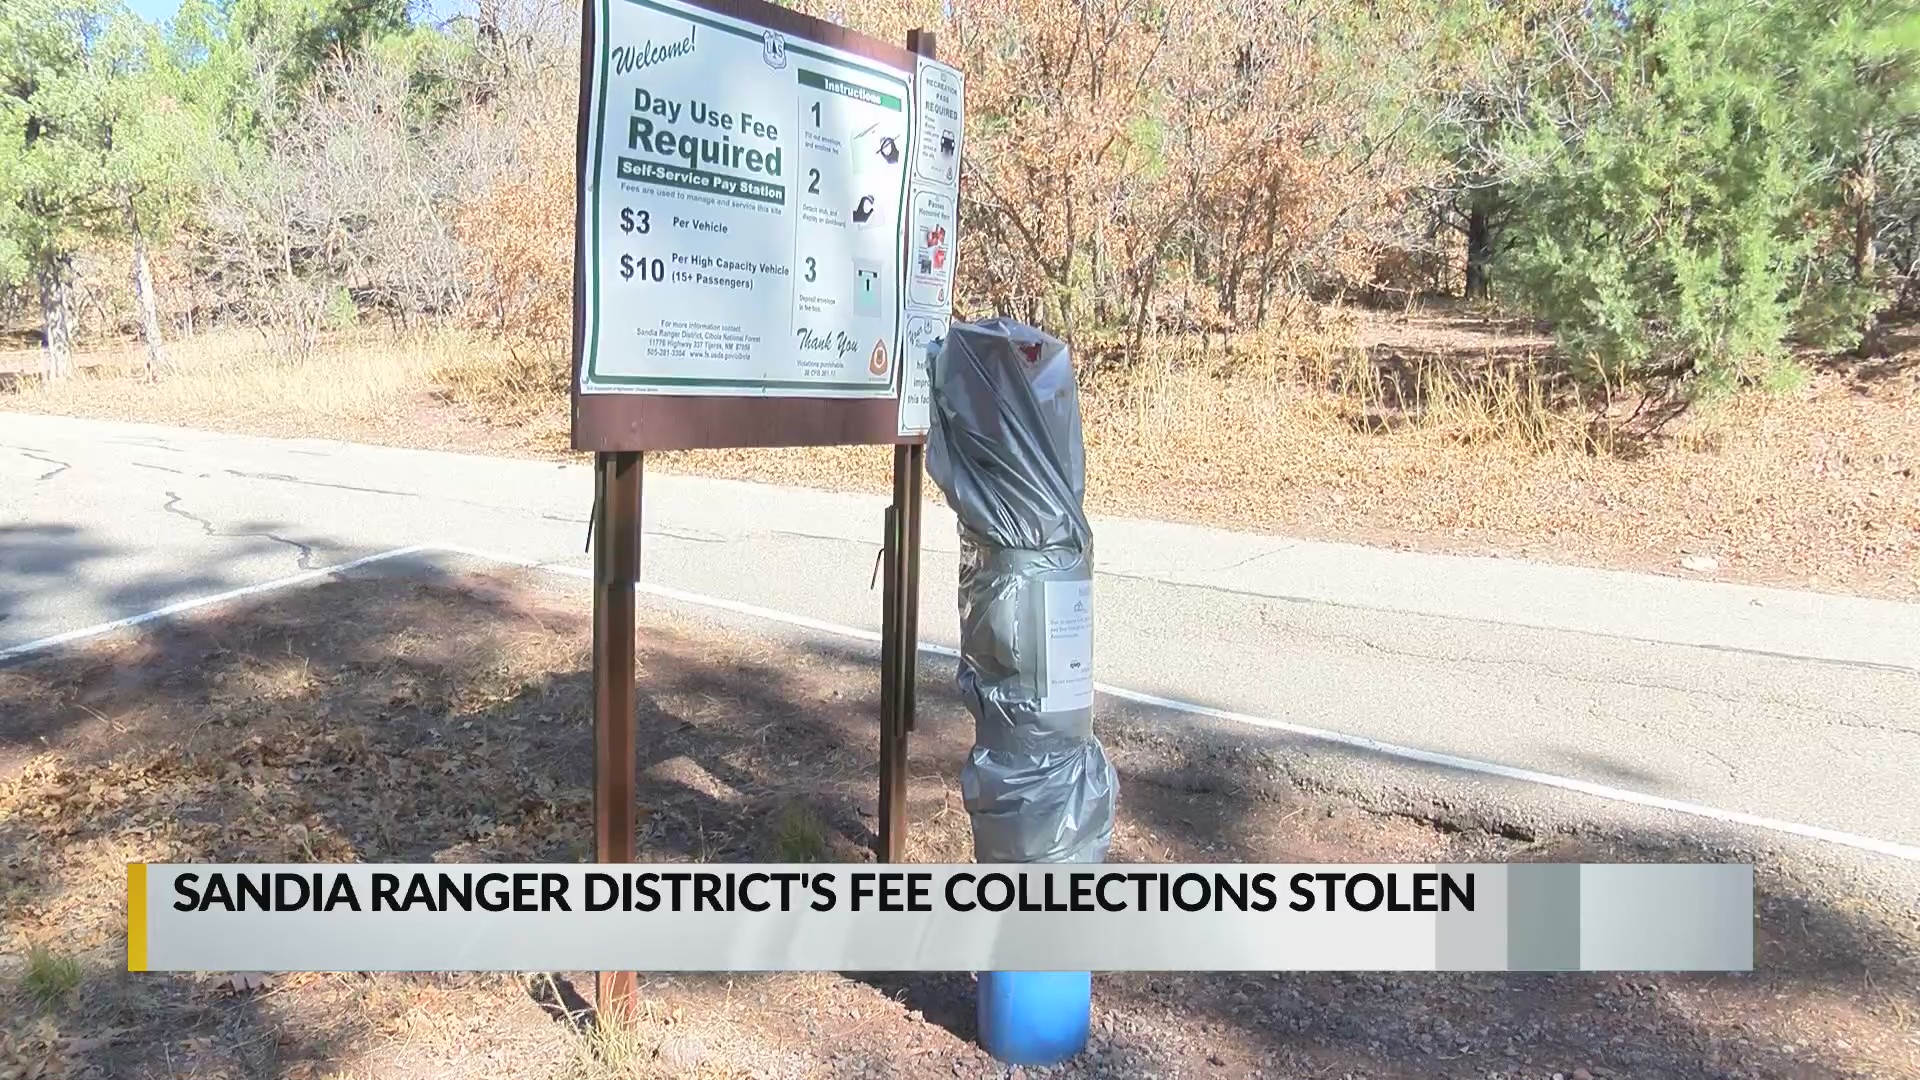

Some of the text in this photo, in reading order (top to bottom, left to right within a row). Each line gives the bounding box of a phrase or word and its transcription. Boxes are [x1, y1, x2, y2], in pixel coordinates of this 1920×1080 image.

[612, 25, 696, 75] Welcome!
[824, 78, 881, 105] Instructions
[926, 78, 958, 96] RECREATION
[936, 93, 949, 103] PASS
[634, 88, 778, 140] Day Use Fee
[811, 101, 821, 128] 1
[925, 101, 958, 120] REQUIRED
[628, 115, 782, 176] Required
[622, 161, 783, 200] Self-Service Pay Station
[808, 168, 820, 195] 2
[620, 182, 640, 193] Fees
[642, 187, 655, 196] are
[656, 189, 676, 199] used
[677, 192, 685, 200] to
[686, 194, 715, 205] manage
[716, 197, 730, 207] and
[620, 206, 651, 236] $3
[673, 216, 728, 234] Per Vehicle
[620, 253, 665, 282] $10
[671, 253, 790, 276] Per High Capacity Vehicle
[804, 256, 817, 283] 3
[671, 271, 754, 290] (15+ Passengers)
[796, 327, 859, 358] Thank You
